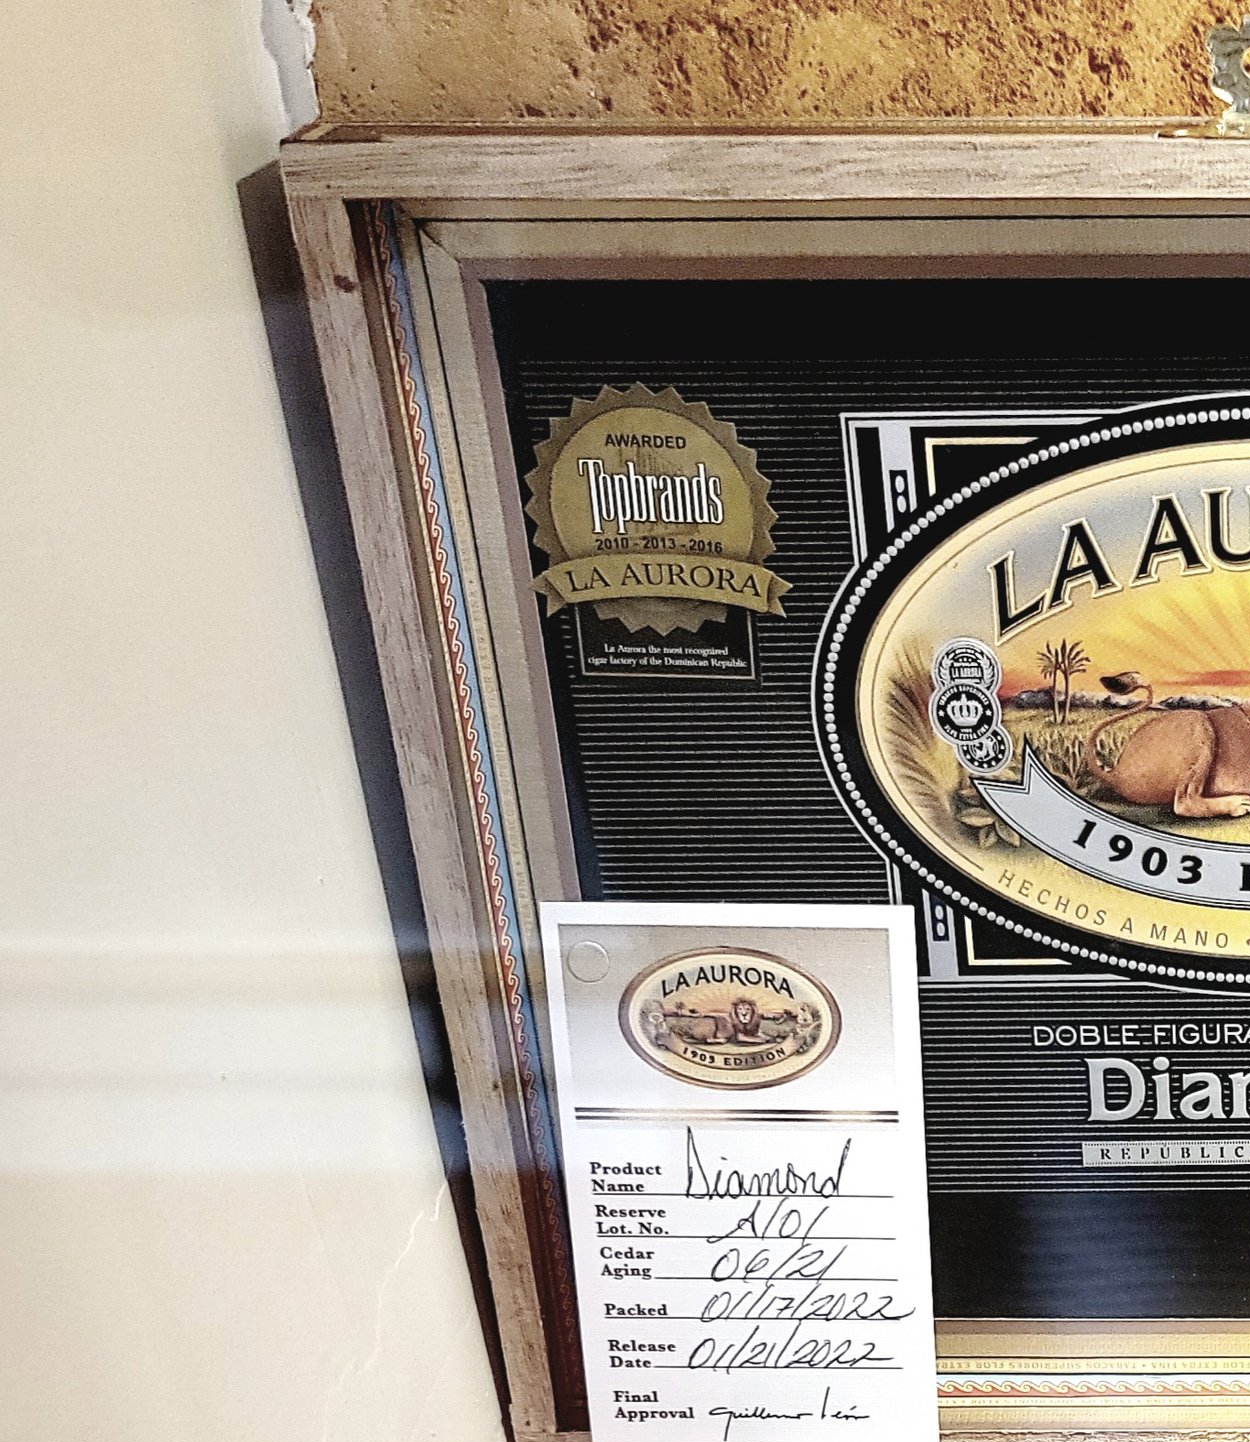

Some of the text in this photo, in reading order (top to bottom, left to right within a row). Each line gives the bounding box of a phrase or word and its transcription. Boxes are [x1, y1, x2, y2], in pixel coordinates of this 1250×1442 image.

[605, 433, 686, 449] AWARDED
[579, 459, 724, 534] Topbrands
[596, 539, 628, 551] 2010
[643, 538, 676, 550] 2013
[689, 539, 723, 553] 2016
[566, 563, 762, 597] LA AURORA
[989, 517, 1124, 643] LA
[648, 644, 661, 654] the
[663, 646, 683, 655] most
[588, 656, 747, 668] cigar factory of the Dominican Republic
[1072, 818, 1203, 885] 1903
[998, 869, 1109, 928] HECHOS
[1120, 918, 1134, 934] A
[1150, 921, 1231, 948] MANO
[661, 965, 796, 999] LA AURORA
[1033, 1024, 1141, 1046] DOBLE
[682, 1047, 788, 1067] 1903 EDITION
[590, 1161, 661, 1176] Product
[686, 1125, 852, 1200] Diamond
[591, 1179, 645, 1193] Name
[594, 1204, 666, 1218] Reserve
[596, 1222, 669, 1235] Lot. No.
[600, 1247, 654, 1260] Cedar
[600, 1263, 652, 1279] Aging
[604, 1303, 667, 1317] Packed
[608, 1340, 676, 1353] Release
[609, 1356, 651, 1368] Date
[974, 1360, 1004, 1370] FLOR
[1008, 1360, 1080, 1370] SUPERIORES
[1085, 1360, 1135, 1370] TABACOS
[613, 1391, 659, 1402] Final
[615, 1407, 694, 1422] Approval
